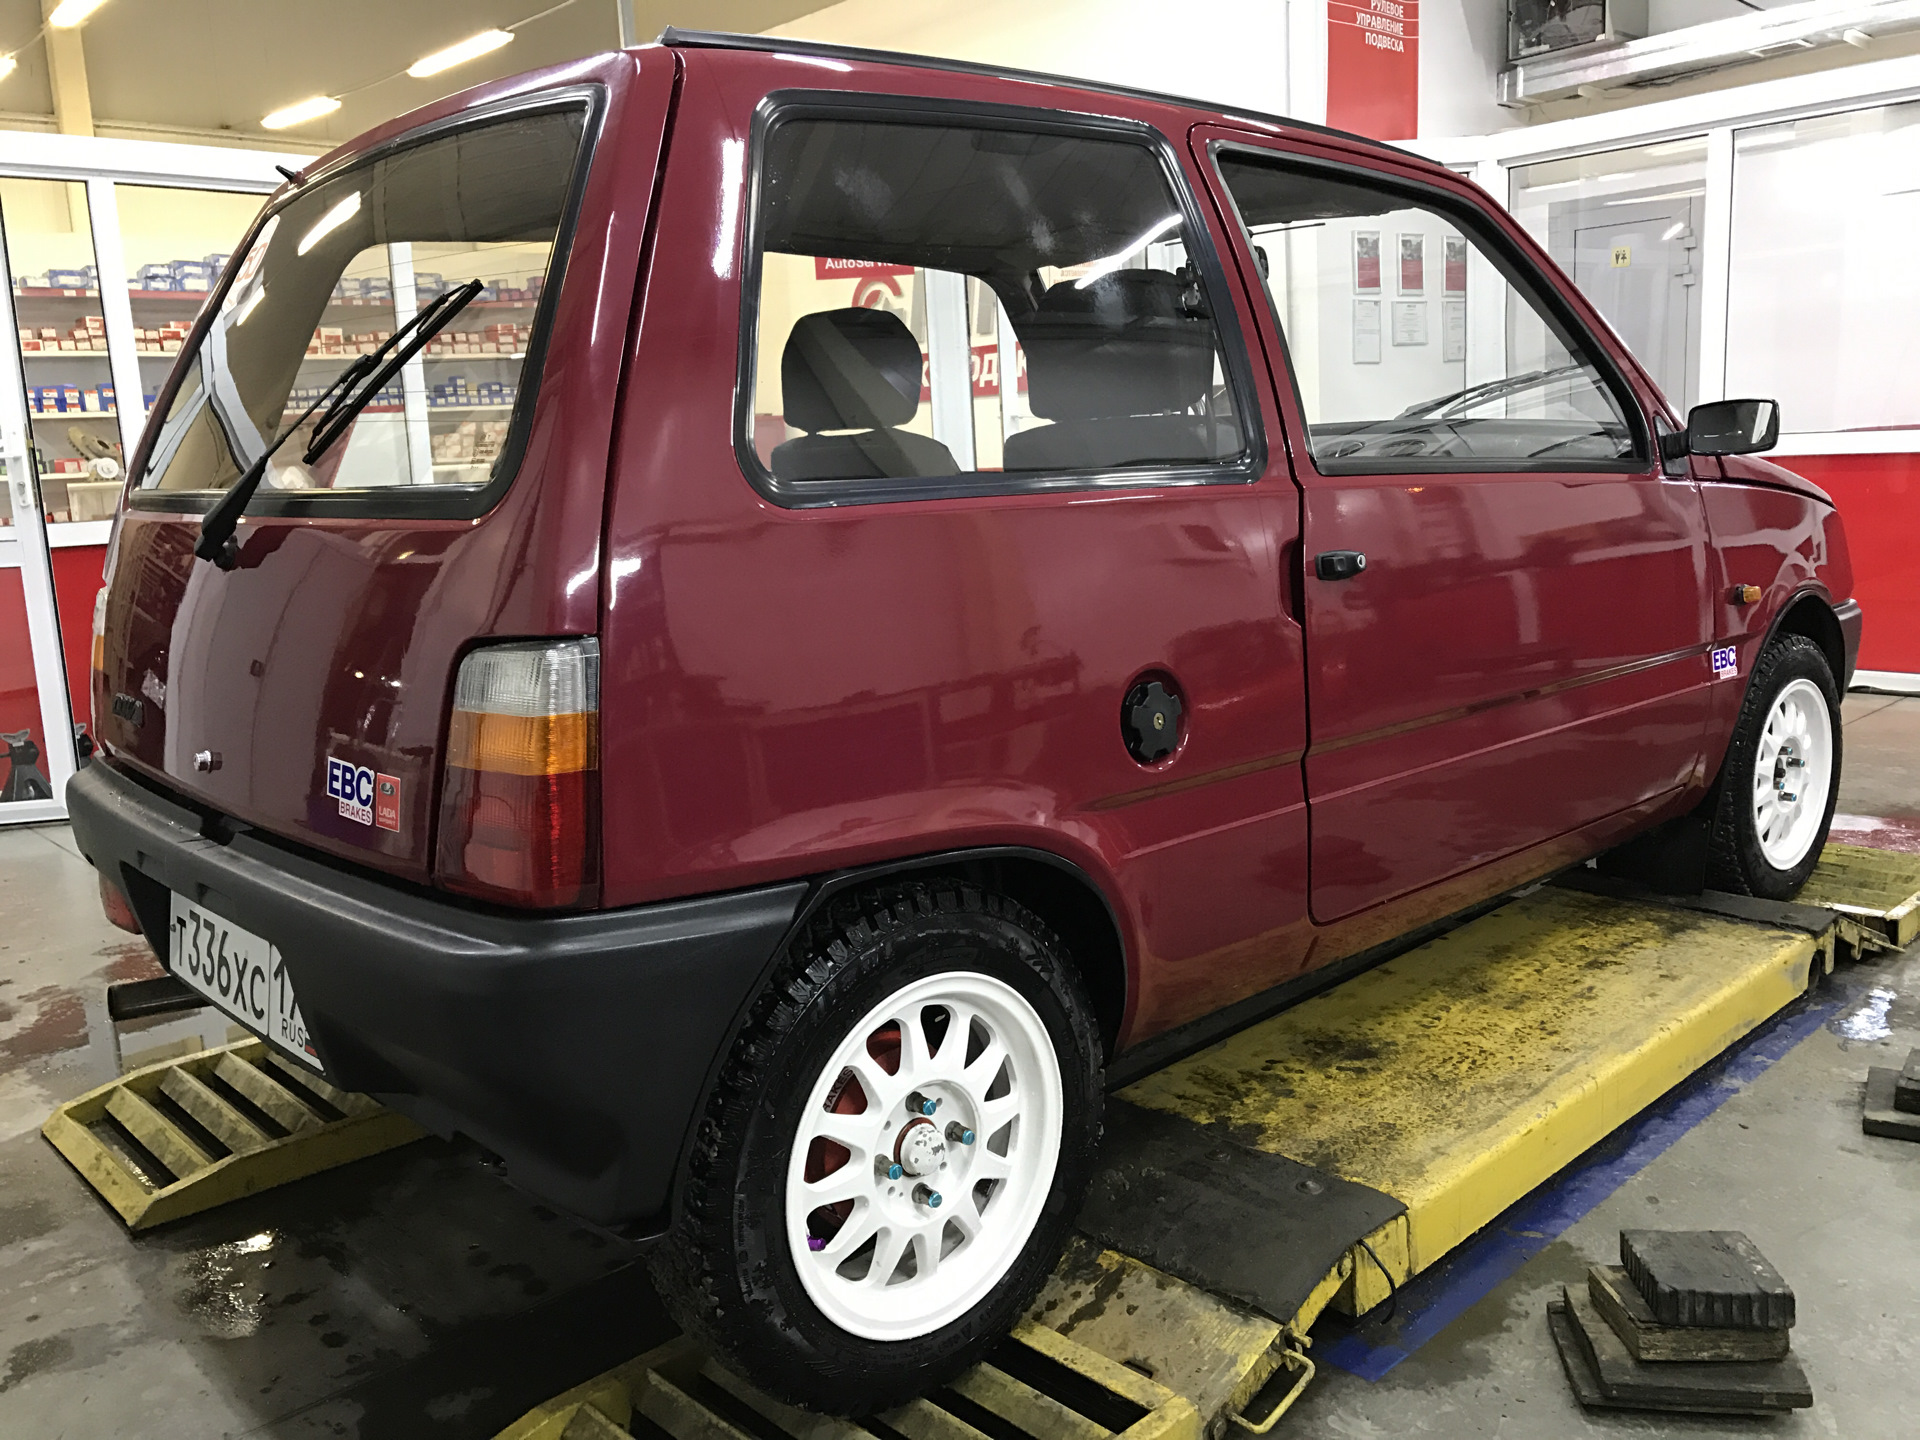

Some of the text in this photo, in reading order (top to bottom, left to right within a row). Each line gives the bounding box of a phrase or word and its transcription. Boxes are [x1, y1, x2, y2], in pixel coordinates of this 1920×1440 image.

[1371, 0, 1404, 18] РУЛЕВОЕ
[1356, 12, 1404, 36] УПРАВЛЕНИЕ
[1365, 32, 1405, 53] ПОДВЕСКА
[1713, 647, 1736, 671] EBC
[328, 760, 372, 807] EBC
[340, 801, 371, 824] BRAKES
[378, 805, 396, 819] LADA
[281, 1017, 304, 1049] RUS
